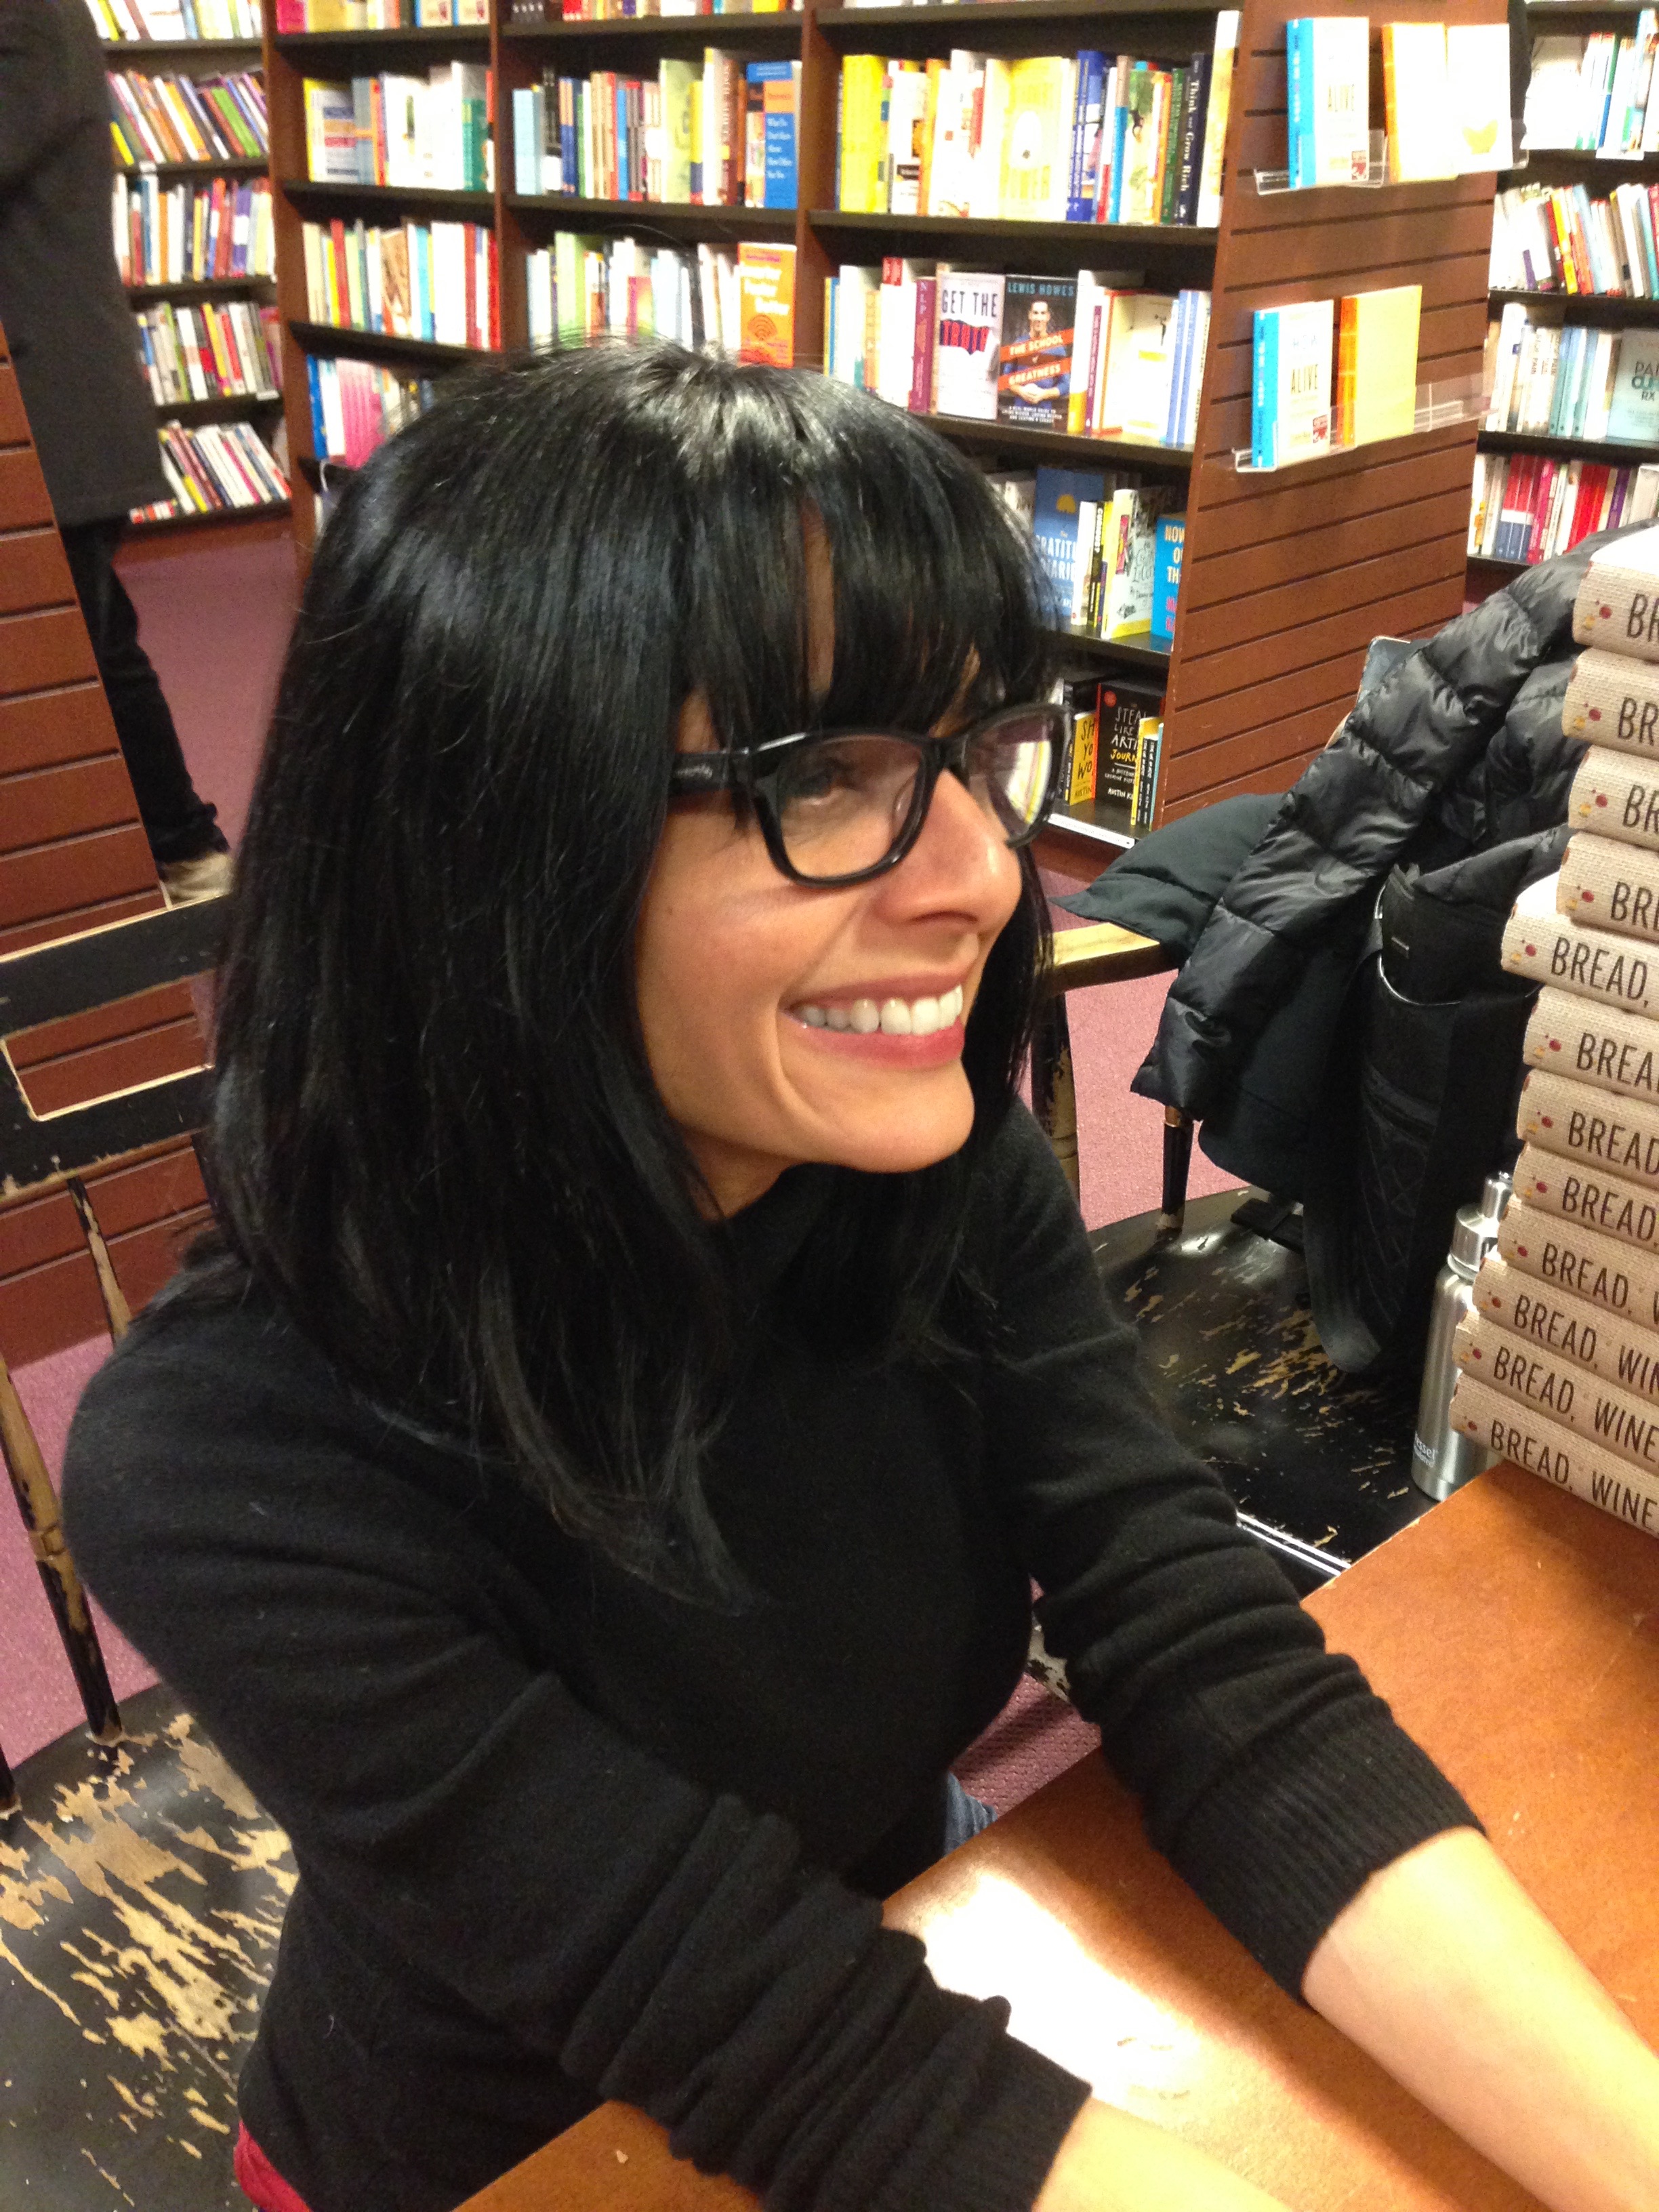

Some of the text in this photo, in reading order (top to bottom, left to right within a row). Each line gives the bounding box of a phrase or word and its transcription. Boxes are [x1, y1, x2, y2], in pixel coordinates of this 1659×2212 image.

[1008, 282, 1036, 294] LEWIS
[942, 289, 999, 317] GET THE
[1029, 335, 1063, 351] SCHOOL
[1008, 363, 1061, 385] GREATNESS
[1291, 364, 1318, 394] ALIVE
[1635, 361, 1659, 377] PA
[1114, 723, 1134, 736] LIKE
[1618, 697, 1659, 746] BR
[1078, 762, 1093, 779] WO
[1576, 1032, 1659, 1094] BREA
[1568, 1111, 1659, 1175] BREAD
[1595, 1397, 1659, 1463] WINE
